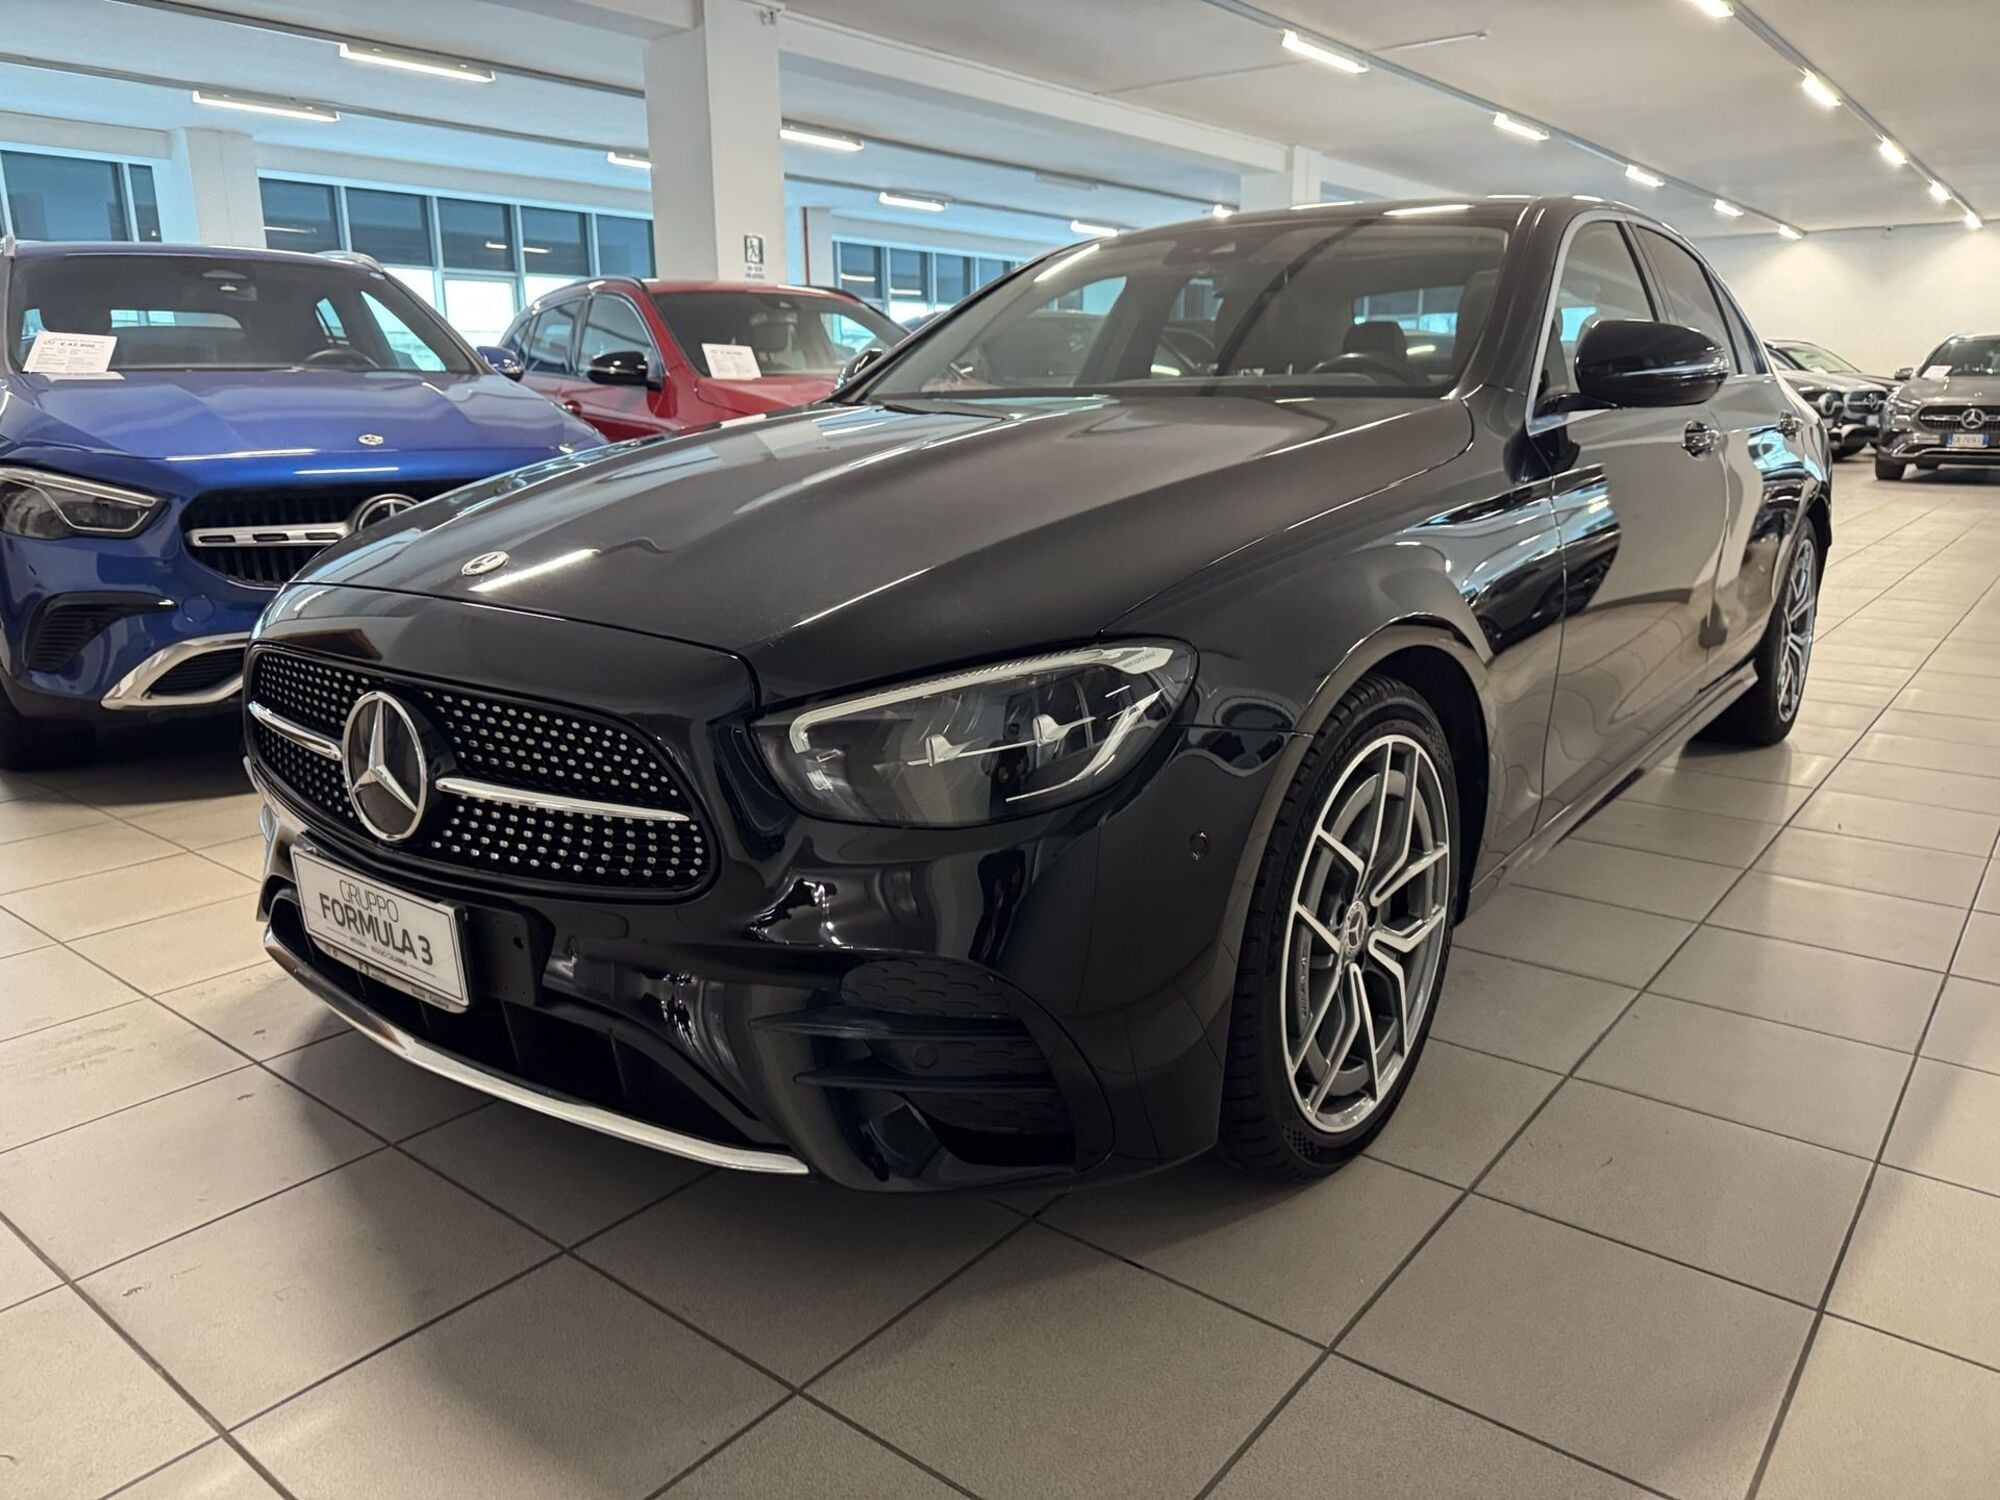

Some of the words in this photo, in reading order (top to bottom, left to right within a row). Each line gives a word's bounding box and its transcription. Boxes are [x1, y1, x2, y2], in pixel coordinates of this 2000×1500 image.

[319, 892, 418, 960] FORMULA
[418, 935, 433, 966] 3
[339, 879, 399, 923] GRUPPO
